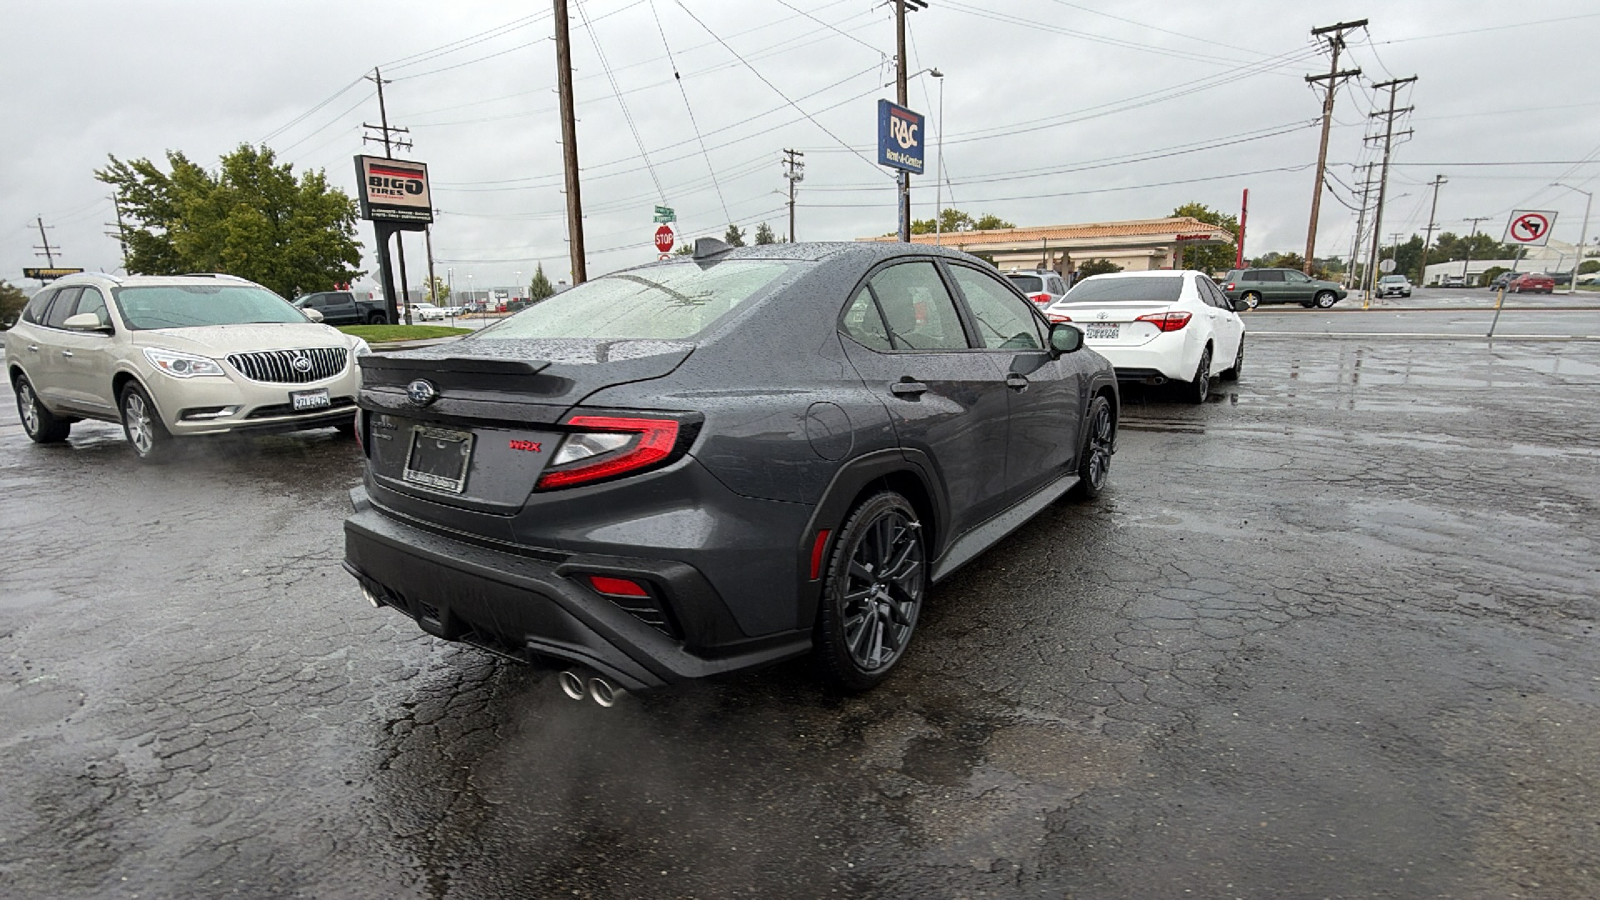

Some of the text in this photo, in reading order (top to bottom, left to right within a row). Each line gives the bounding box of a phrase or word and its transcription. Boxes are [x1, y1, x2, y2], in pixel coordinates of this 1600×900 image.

[890, 115, 918, 149] RAC
[886, 148, 922, 168] Rent-A-Center
[369, 176, 404, 189] BIG
[369, 187, 404, 196] TIRES
[656, 233, 674, 245] STOP
[509, 439, 543, 453] WRX
